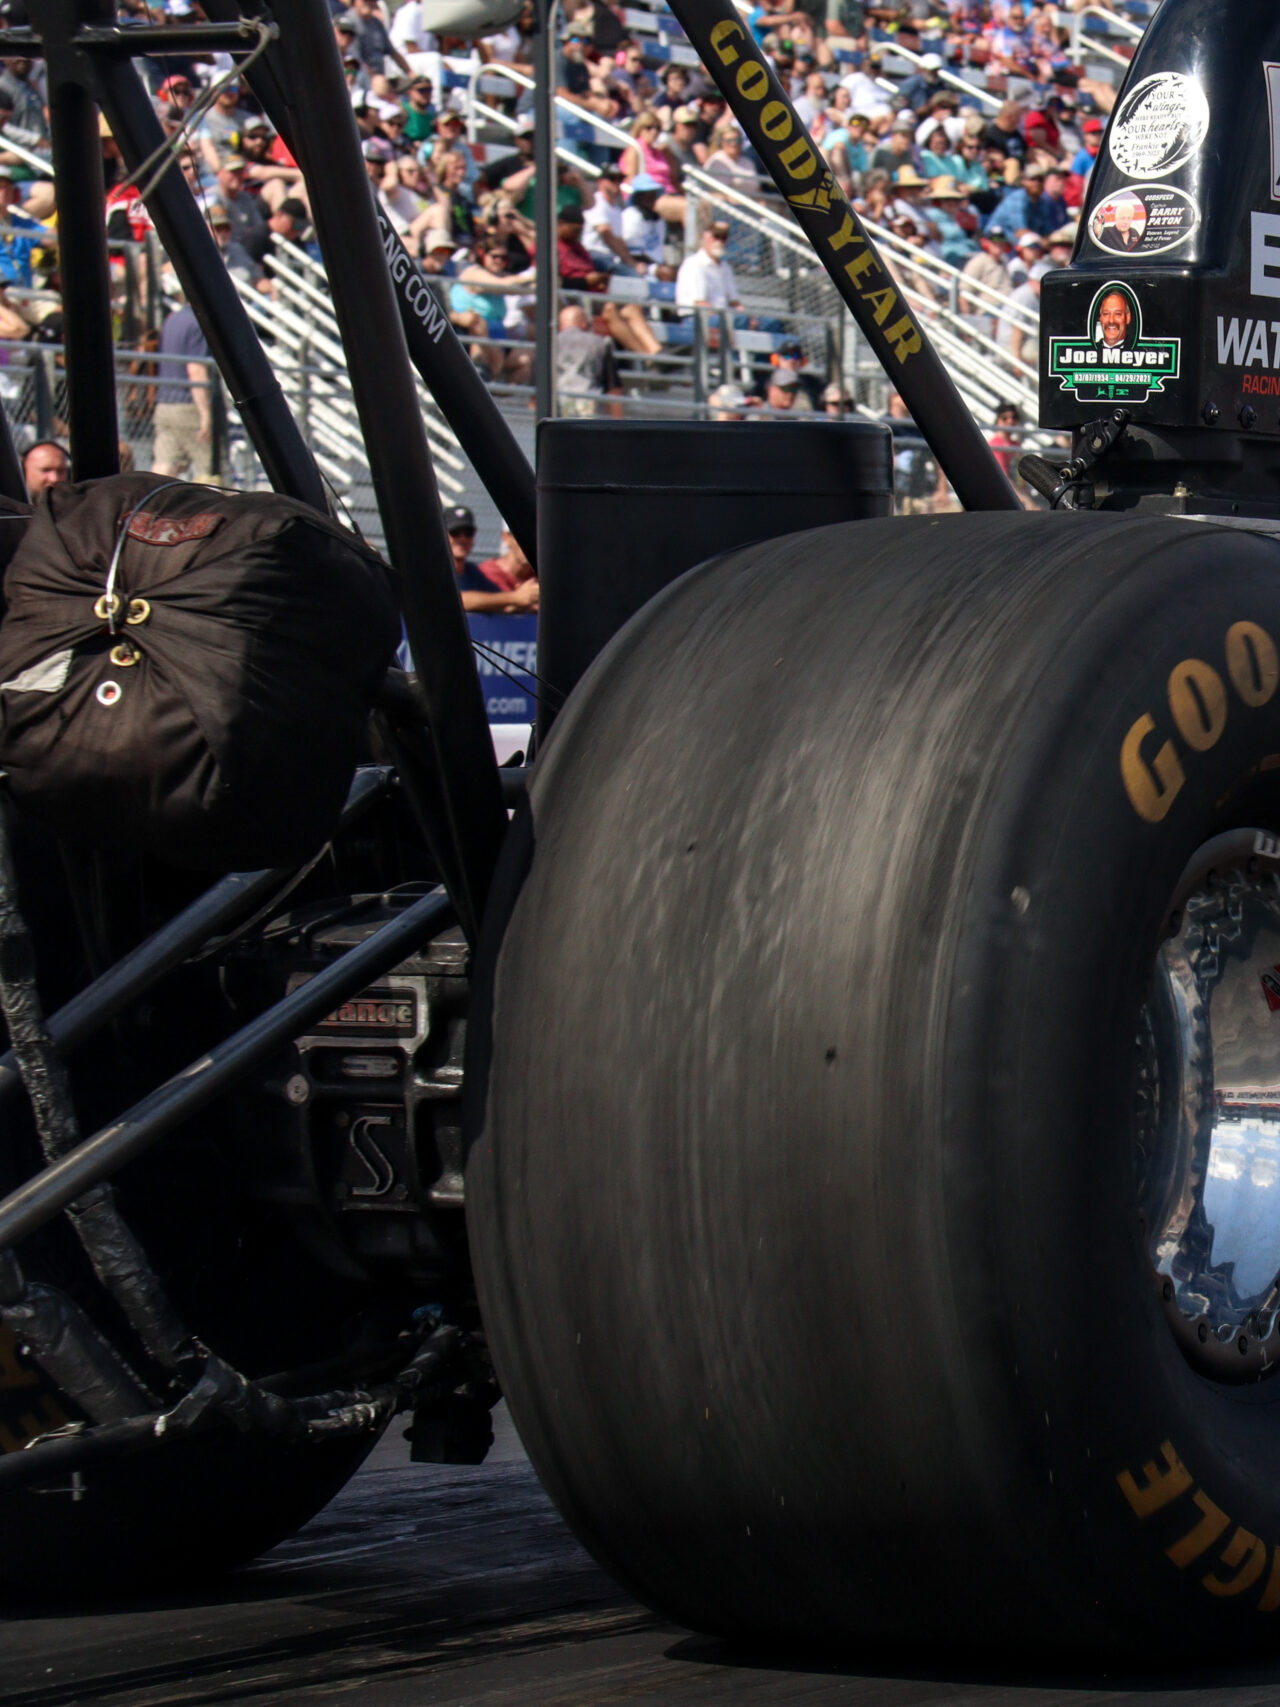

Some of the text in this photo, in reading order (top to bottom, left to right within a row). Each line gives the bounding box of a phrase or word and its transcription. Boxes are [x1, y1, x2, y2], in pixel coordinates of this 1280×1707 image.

[1152, 91, 1175, 100] YOUR
[1153, 101, 1180, 114] wings
[1149, 119, 1180, 132] hearts
[1150, 207, 1185, 217] BARRY
[1147, 216, 1183, 226] PATON
[1059, 348, 1170, 367] Joe Meyer
[324, 1002, 412, 1026] ange
